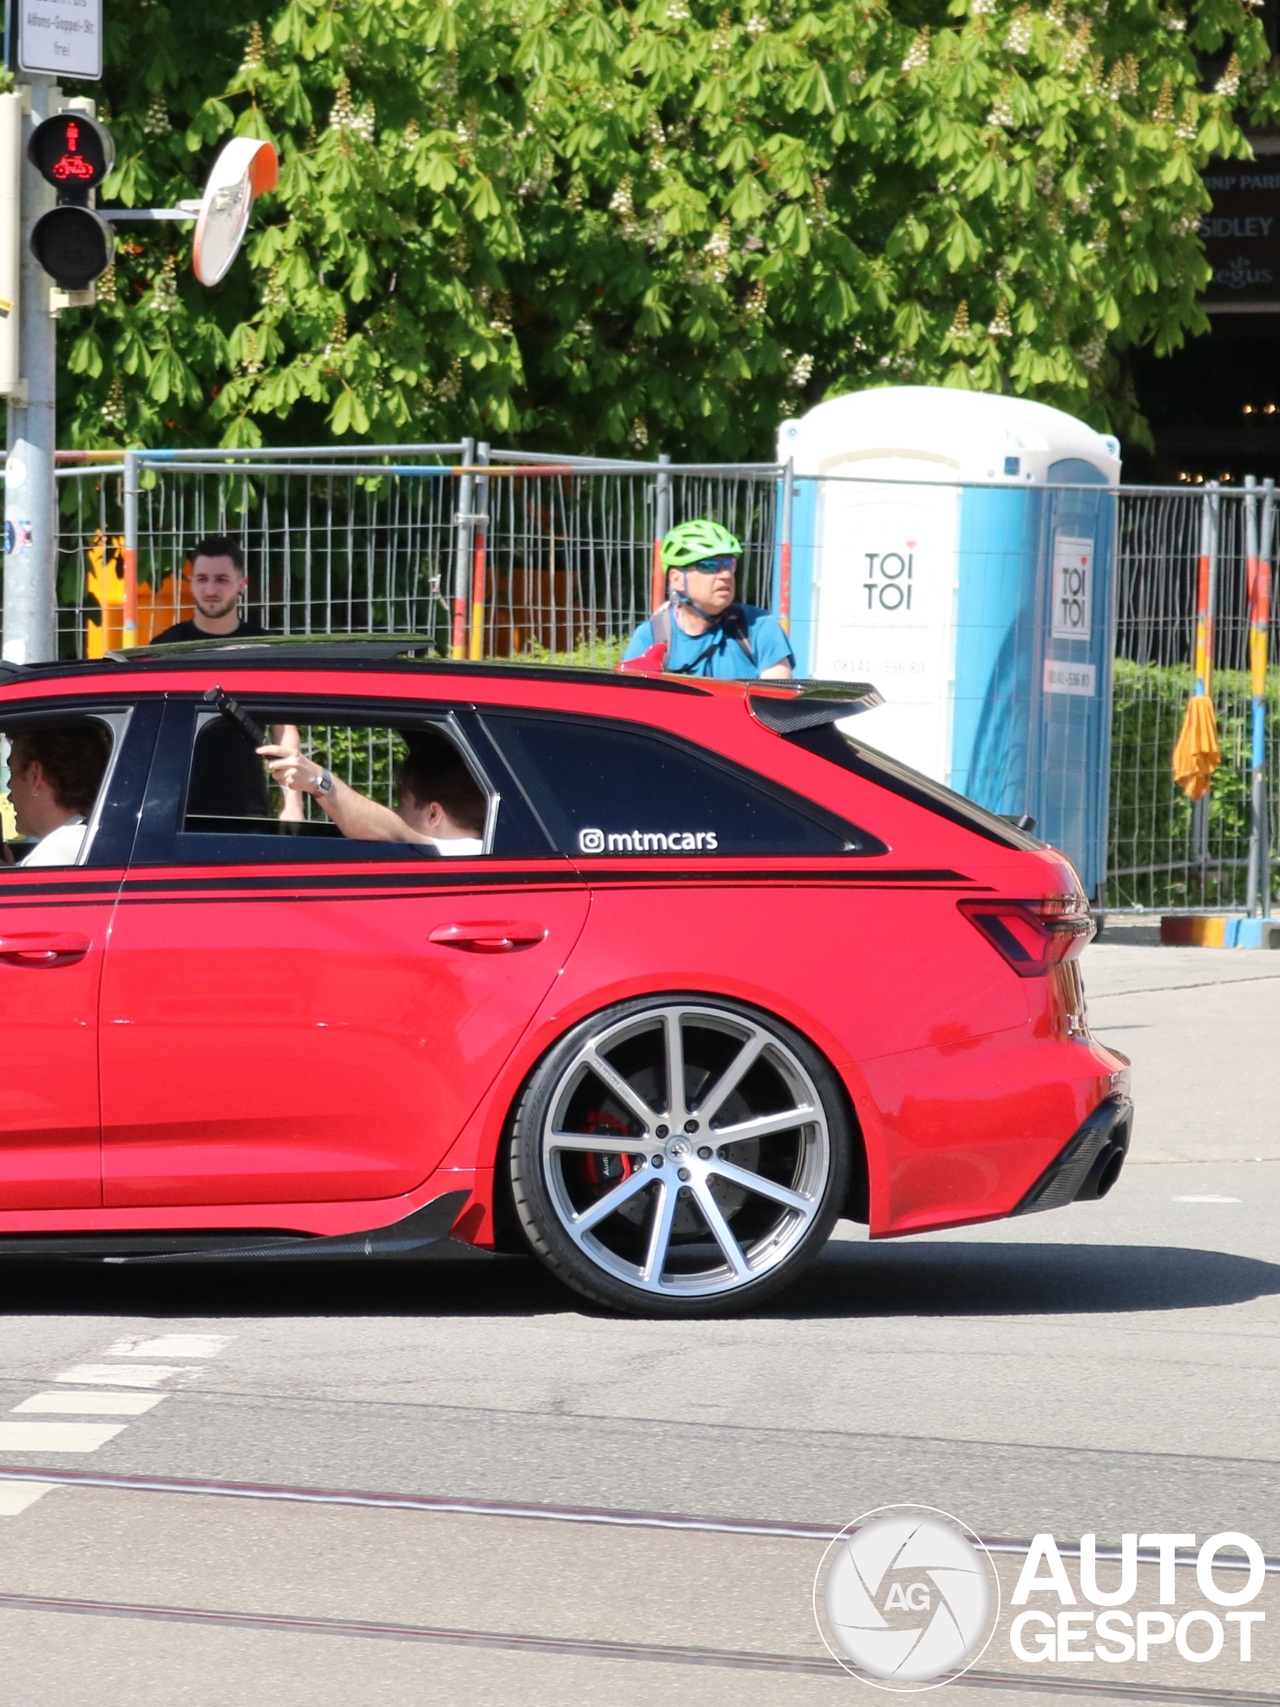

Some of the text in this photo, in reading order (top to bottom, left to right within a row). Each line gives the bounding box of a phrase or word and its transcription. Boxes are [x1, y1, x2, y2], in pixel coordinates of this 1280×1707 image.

[1200, 216, 1273, 237] SIDLEY
[1212, 268, 1273, 289] egus
[865, 552, 913, 579] TOI
[1063, 567, 1086, 597] TOI
[863, 583, 912, 610] TOI
[1061, 598, 1086, 627] TOI
[833, 659, 872, 673] 08141
[909, 662, 926, 675] 80
[607, 830, 718, 852] mtmcars
